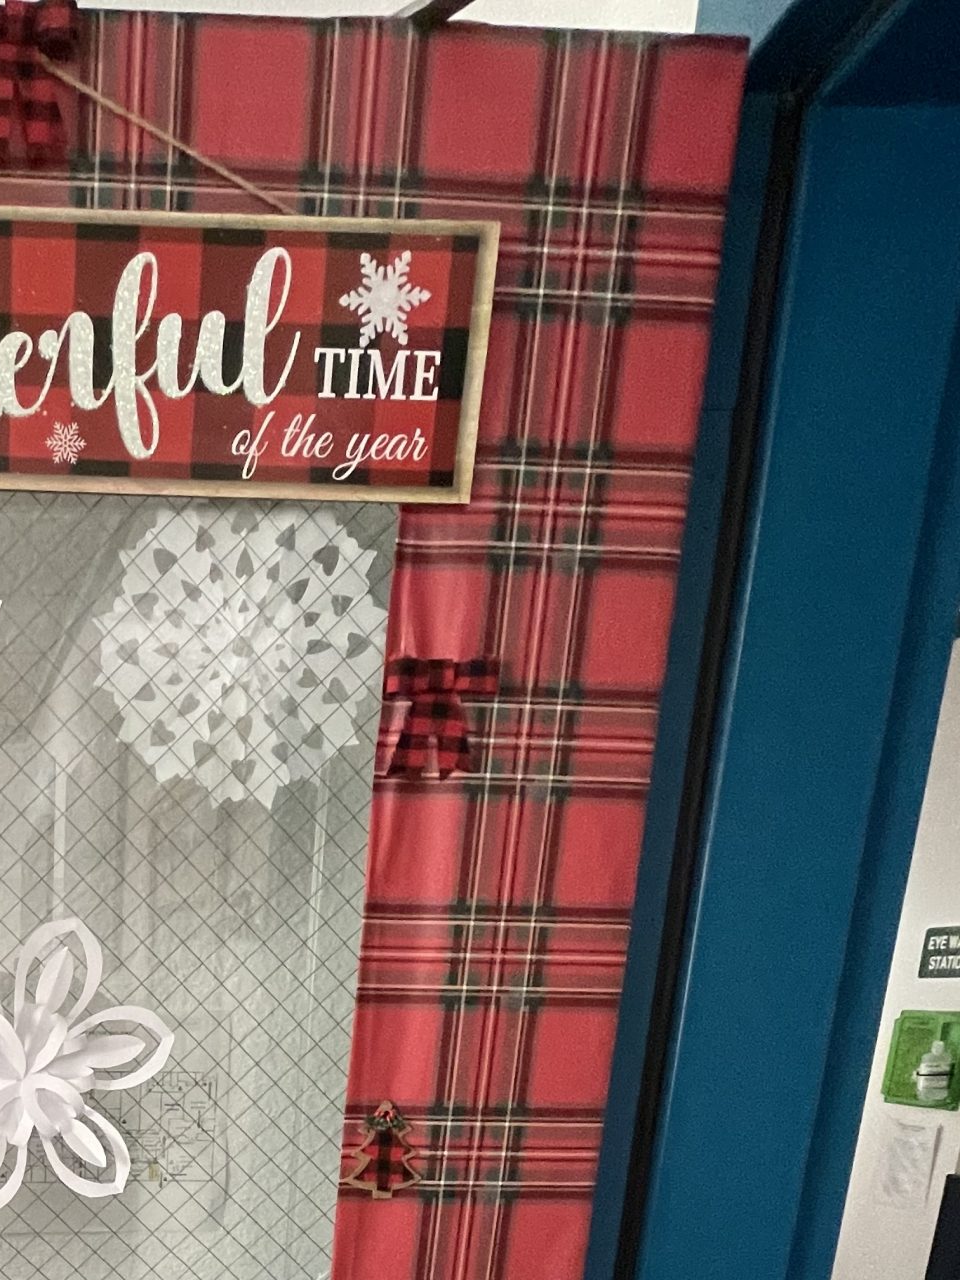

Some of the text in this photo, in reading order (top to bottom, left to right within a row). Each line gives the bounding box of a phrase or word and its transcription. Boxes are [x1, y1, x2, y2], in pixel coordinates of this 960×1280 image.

[314, 347, 441, 401] TIME
[231, 410, 428, 481] of the year
[928, 935, 948, 950] EYE
